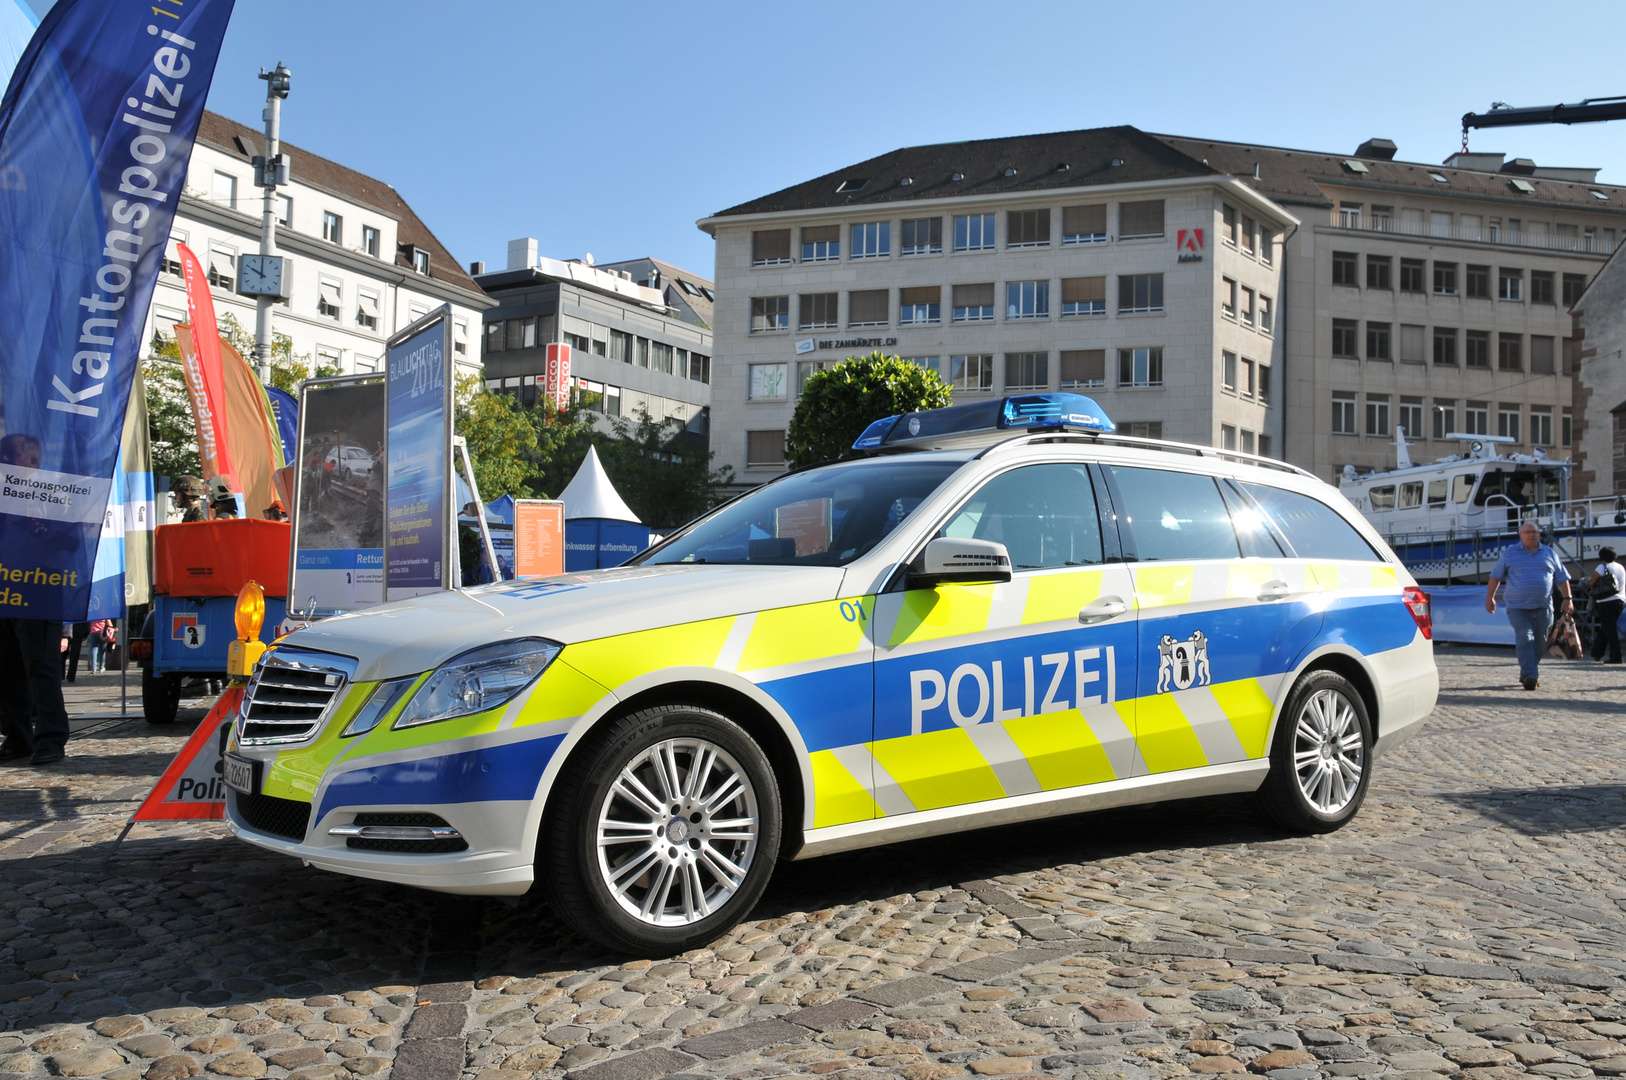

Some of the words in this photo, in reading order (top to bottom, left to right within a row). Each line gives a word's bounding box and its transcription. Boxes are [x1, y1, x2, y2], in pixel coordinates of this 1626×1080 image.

[46, 24, 196, 417] Kantonspolizei
[819, 340, 834, 349] DIE
[835, 337, 897, 349] ZAHNÄRZTE.CH
[411, 350, 442, 399] 2012
[5, 474, 92, 496] Kantonspolizei
[2, 487, 73, 506] Basel-Stadt
[600, 543, 638, 554] aufbereitung
[300, 555, 316, 564] Ganz
[317, 555, 331, 565] nah.
[839, 601, 868, 622] 01
[910, 646, 1117, 736] POLIZEI
